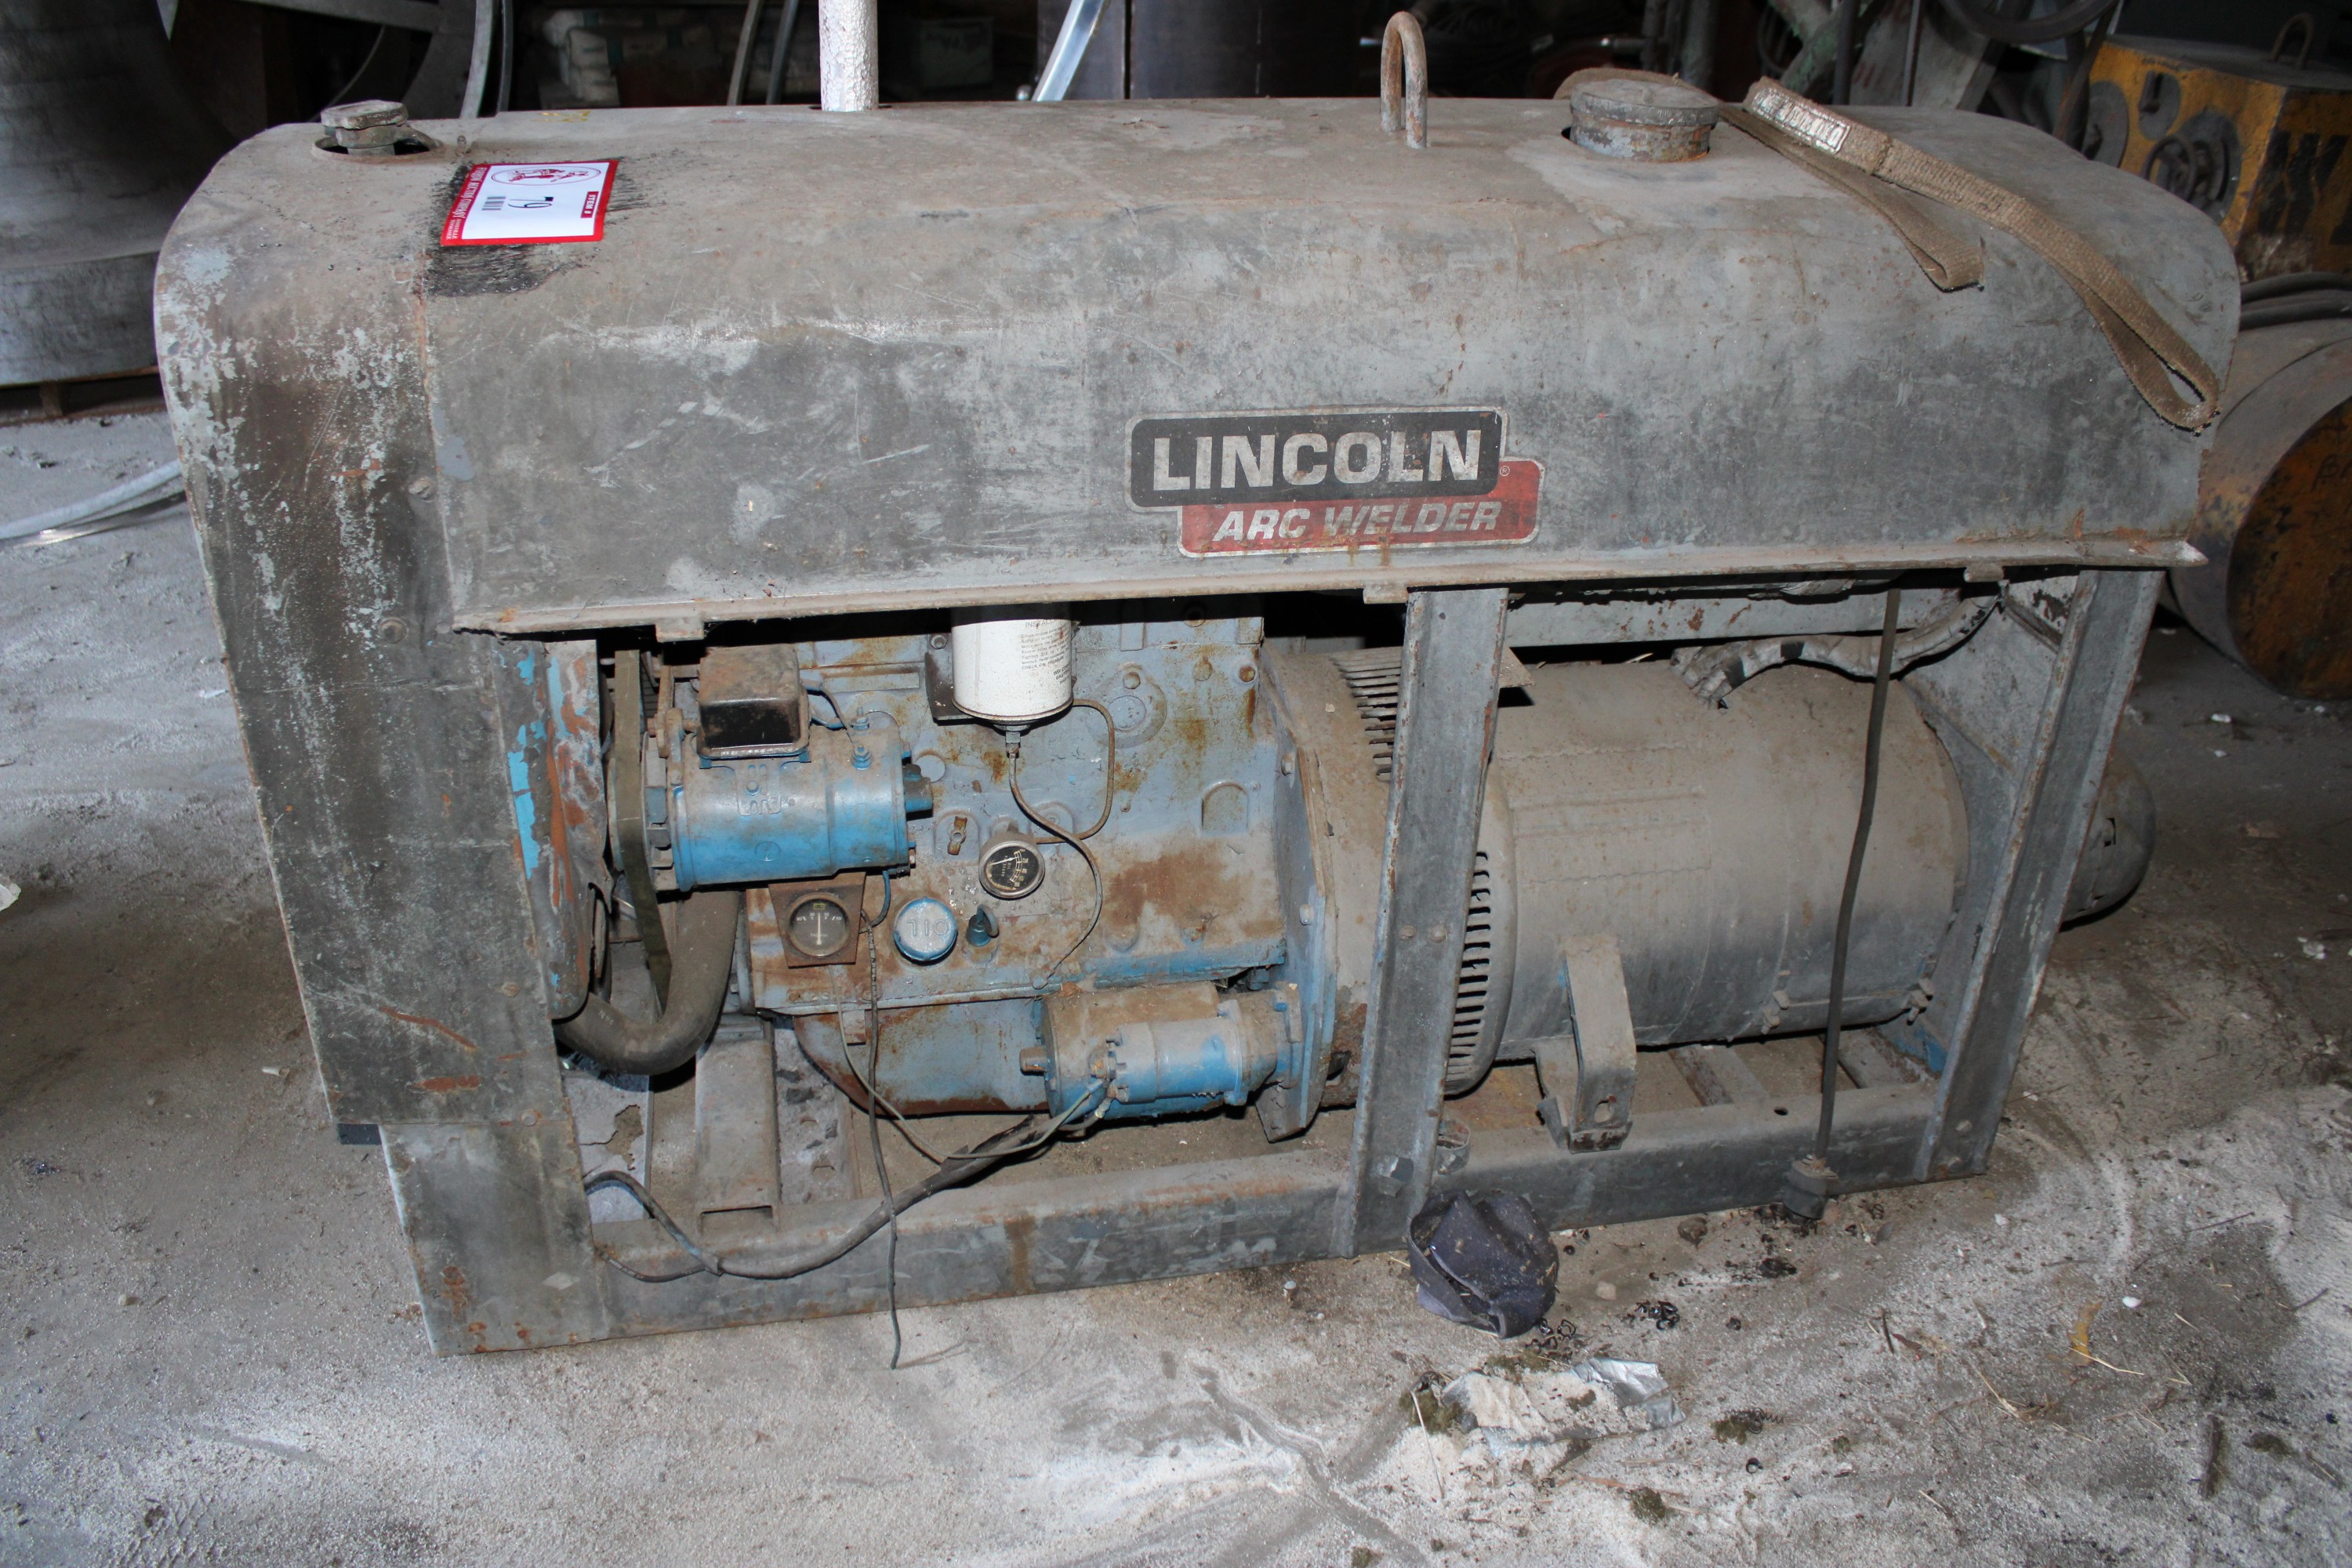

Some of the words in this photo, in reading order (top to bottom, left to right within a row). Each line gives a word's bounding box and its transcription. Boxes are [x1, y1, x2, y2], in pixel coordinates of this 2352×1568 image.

[508, 196, 554, 209] 79
[585, 194, 596, 209] ITEM
[1152, 429, 1481, 491] LINCOLN
[1213, 508, 1310, 541] ARC
[1323, 502, 1502, 535] WELDER
[907, 919, 947, 936] OIL
